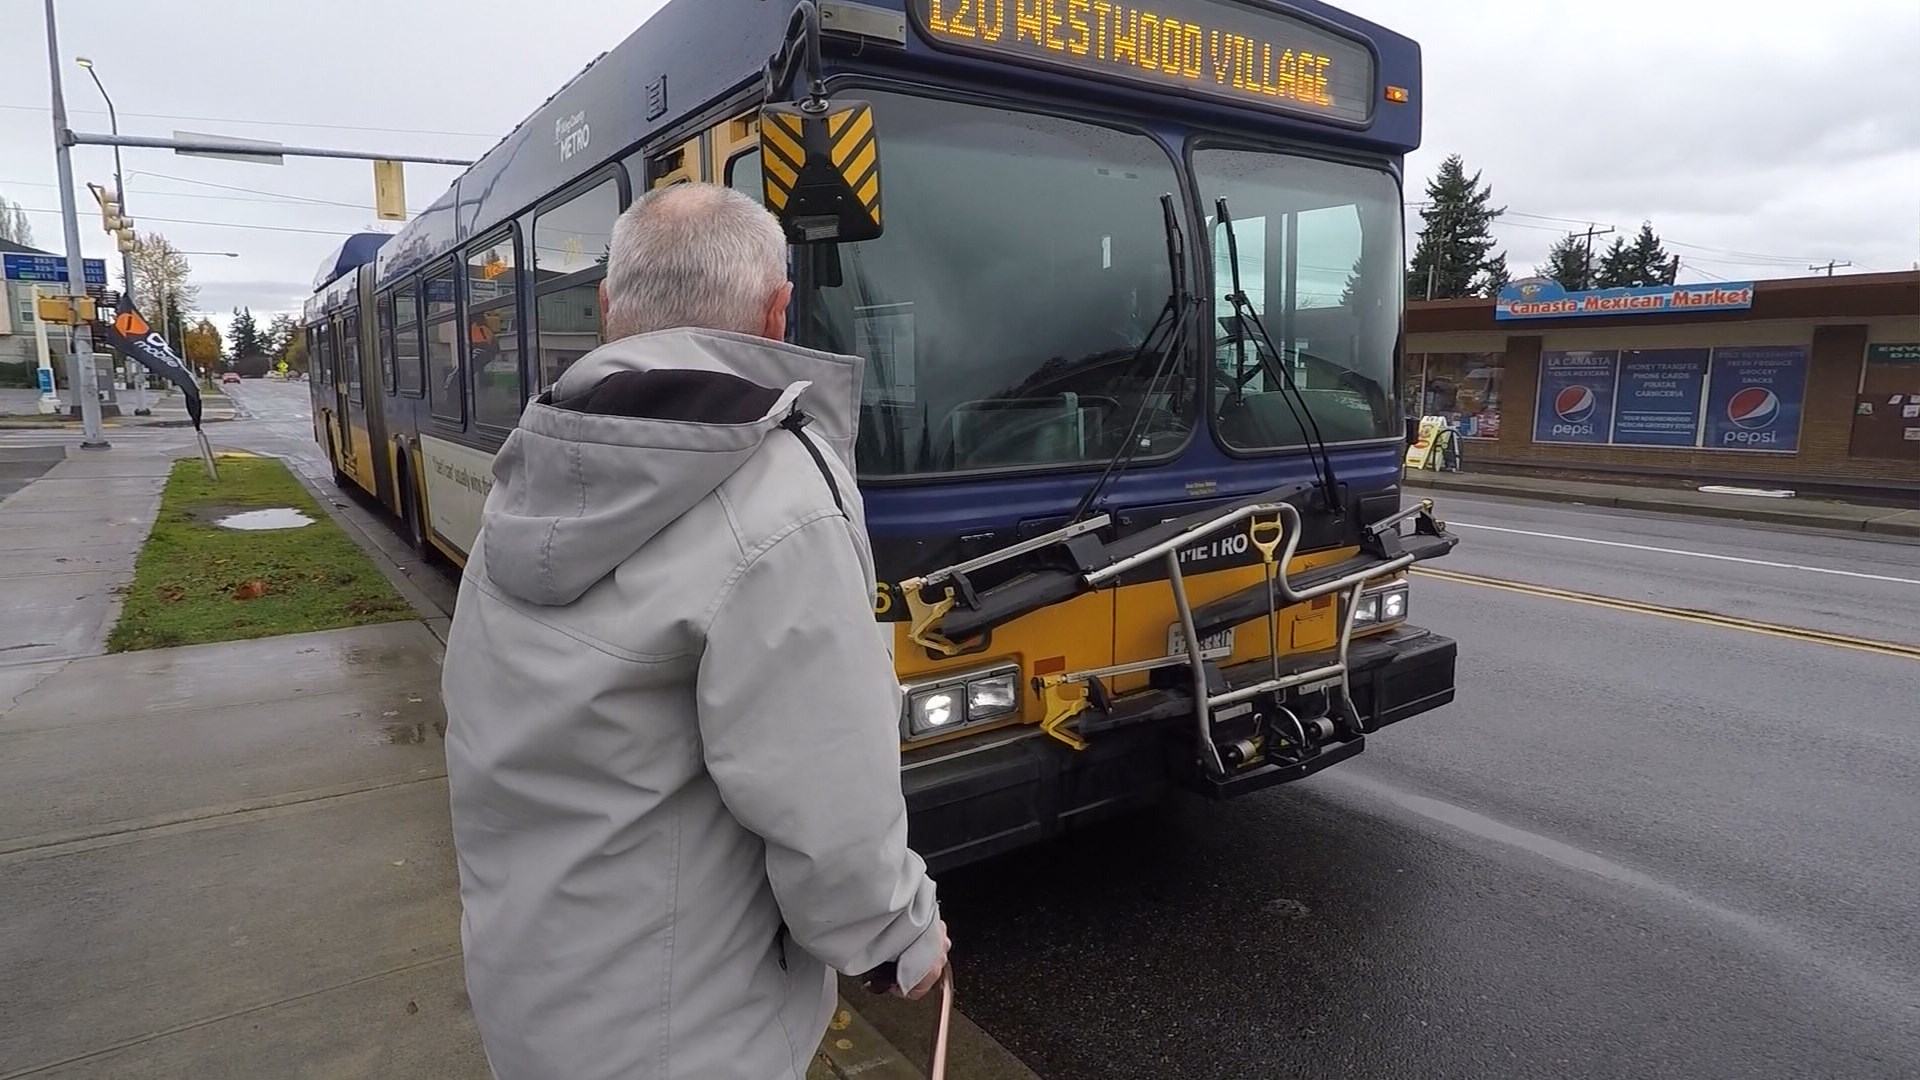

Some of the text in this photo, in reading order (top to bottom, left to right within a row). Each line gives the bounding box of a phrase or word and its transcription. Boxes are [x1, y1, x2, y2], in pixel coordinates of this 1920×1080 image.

[1016, 0, 1202, 79] WESTWOOD
[1210, 30, 1332, 106] VILLAGE
[560, 123, 590, 163] METRO
[1509, 298, 1578, 316] Canasta
[1583, 292, 1664, 313] Mexican
[1671, 287, 1751, 308] Market
[133, 340, 179, 368] mobile
[1547, 357, 1611, 366] LA CANASTA
[1552, 423, 1595, 437] pepsi
[1723, 430, 1777, 445] pepsi
[1180, 533, 1249, 563] METRO
